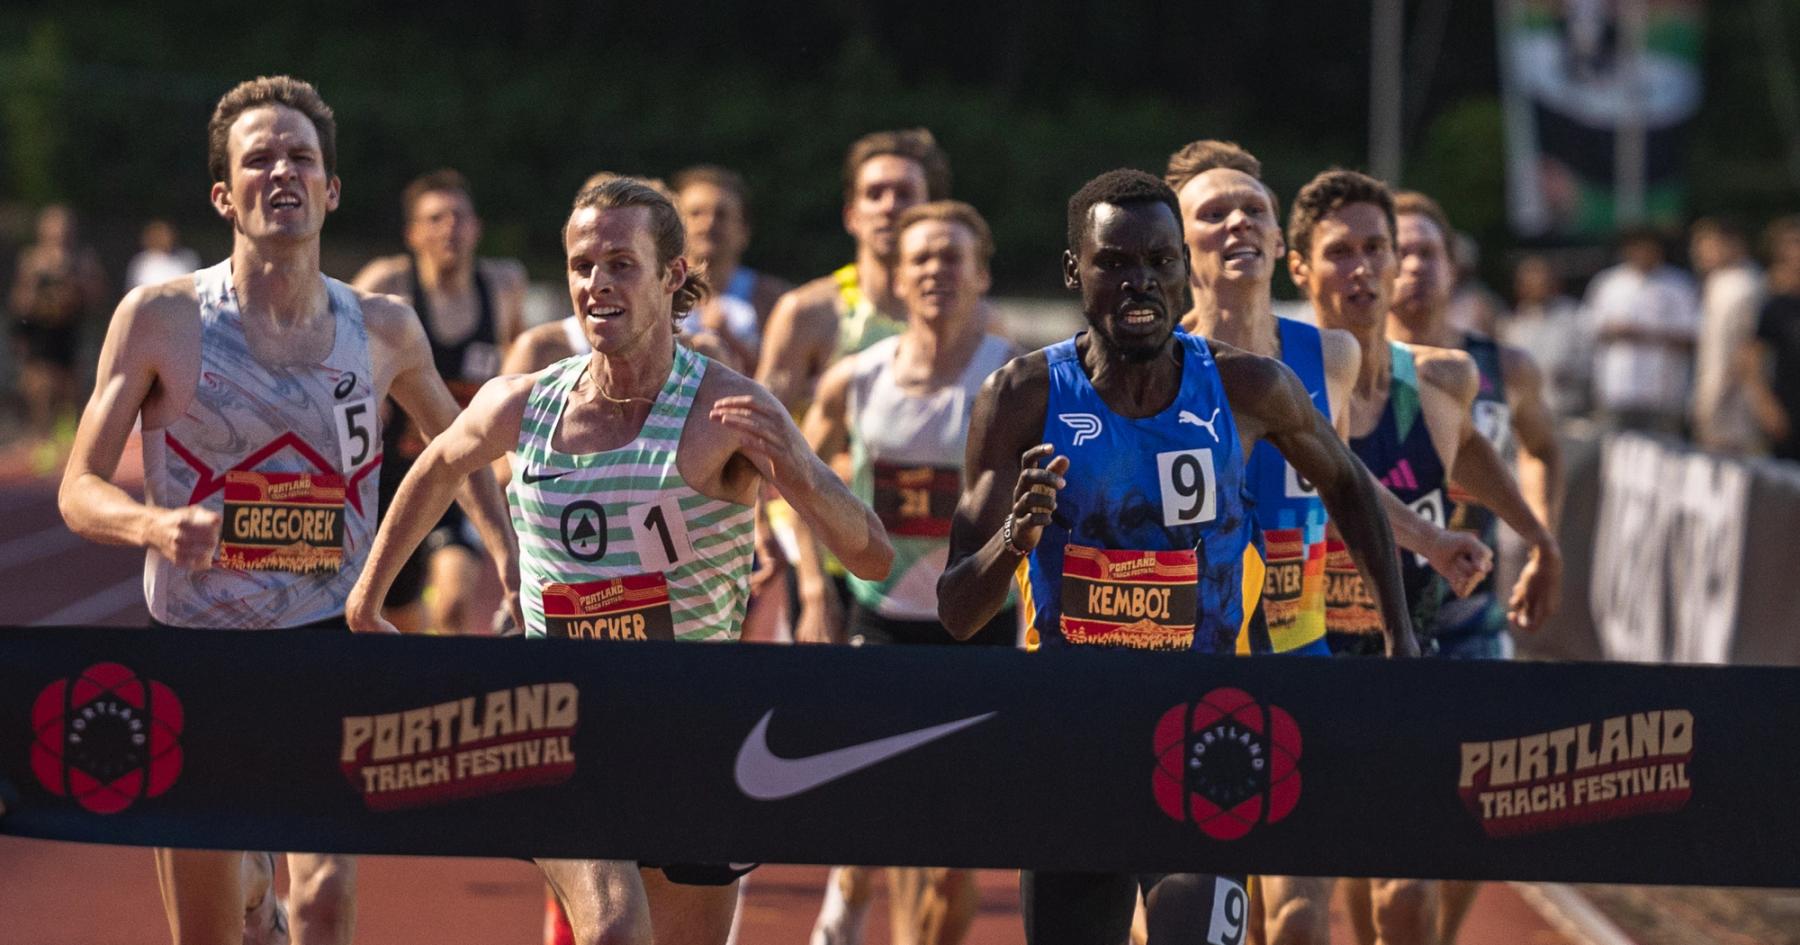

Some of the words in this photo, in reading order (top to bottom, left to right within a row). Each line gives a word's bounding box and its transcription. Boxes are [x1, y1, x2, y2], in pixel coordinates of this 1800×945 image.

[345, 403, 370, 466] 5
[1171, 453, 1205, 521] 9
[234, 507, 336, 541] GREGOREK
[643, 505, 679, 564] 1
[1109, 557, 1156, 573] PORTLAND
[1265, 563, 1301, 595] EYER
[579, 584, 624, 606] PORTLAND
[1088, 584, 1171, 619] KEMBOI
[567, 613, 648, 641] HOCKER
[341, 682, 580, 762] PORTLAND
[1190, 726, 1265, 770] PORTLAND
[1459, 709, 1694, 787] PORTLAND
[361, 756, 450, 793] TRACK
[455, 736, 576, 780] FESTIVAL
[1479, 782, 1567, 819] TRACK
[1572, 763, 1691, 805] FESTIVAL
[1221, 887, 1245, 945] 9
